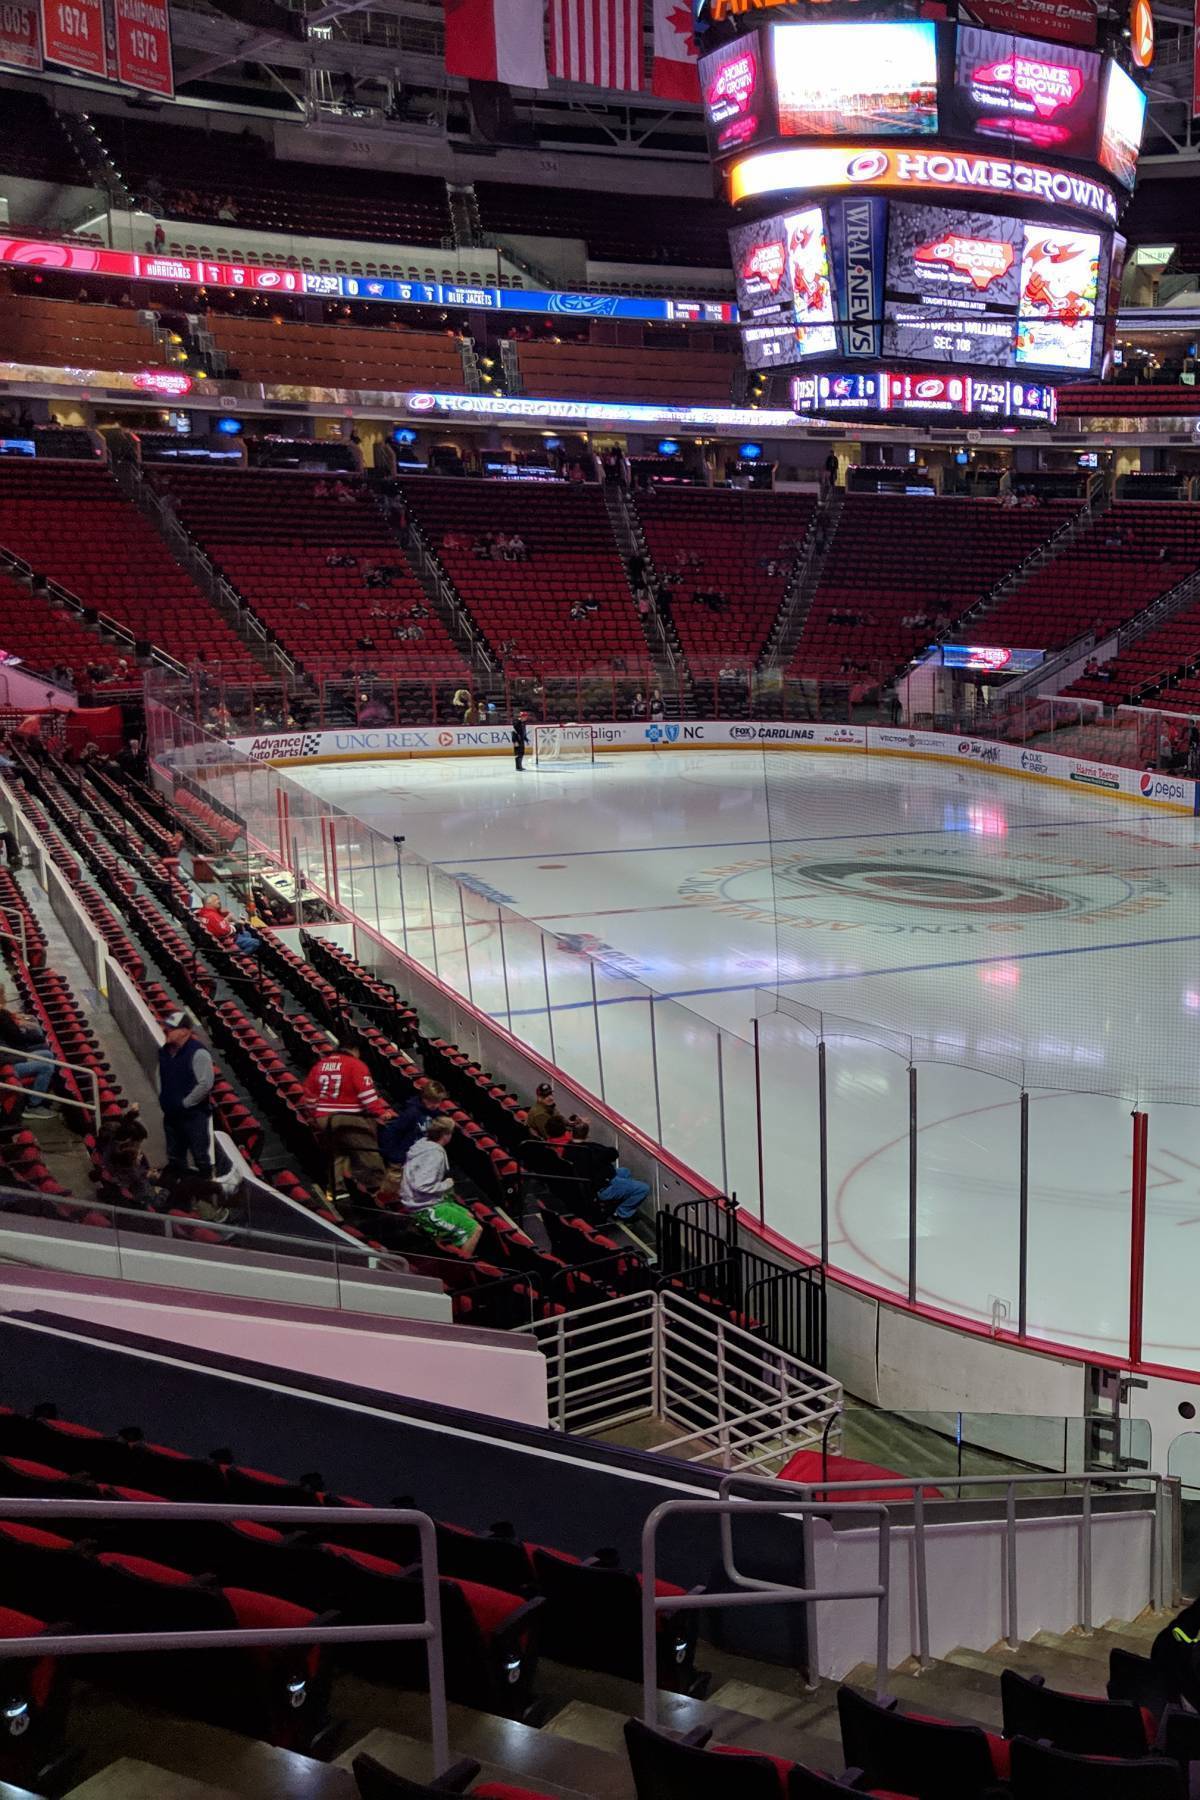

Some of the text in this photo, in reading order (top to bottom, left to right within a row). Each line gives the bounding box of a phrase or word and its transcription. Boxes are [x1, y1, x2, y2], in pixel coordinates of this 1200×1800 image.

[0, 7, 30, 36] 005
[58, 4, 88, 40] 1974
[118, 0, 166, 32] CHAMPIONS
[130, 29, 157, 63] 1973
[724, 59, 748, 79] HOME
[1016, 60, 1070, 83] HOME
[727, 73, 752, 94] GROWN
[1016, 76, 1073, 98] GROWN
[897, 154, 1105, 212] HOMEGROWN
[954, 240, 1004, 258] HOME
[953, 253, 1006, 270] GROWN
[147, 264, 191, 279] HURRICANES
[846, 203, 872, 351] WRAL NEWS
[285, 275, 295, 290] 0
[307, 275, 338, 289] 27:52
[349, 280, 359, 295] 0
[402, 289, 411, 299] 0
[448, 292, 492, 306] BLUE JACKETS
[934, 336, 954, 351] SEC.
[948, 379, 963, 401] 0
[973, 383, 1005, 404] 27:52
[1012, 385, 1023, 406] 0
[440, 396, 590, 419] HOMEGROWN
[336, 732, 430, 750] UNC REX
[457, 732, 488, 745] PNC
[563, 728, 622, 741] invisalign
[684, 726, 704, 739] NC
[735, 728, 751, 738] FOX
[759, 727, 814, 740] CAROLINAS
[880, 735, 906, 743] VECTOR
[252, 736, 300, 751] Advance
[271, 748, 299, 760] Parts
[1155, 781, 1185, 799] pepsi
[321, 1062, 342, 1072] FAULK
